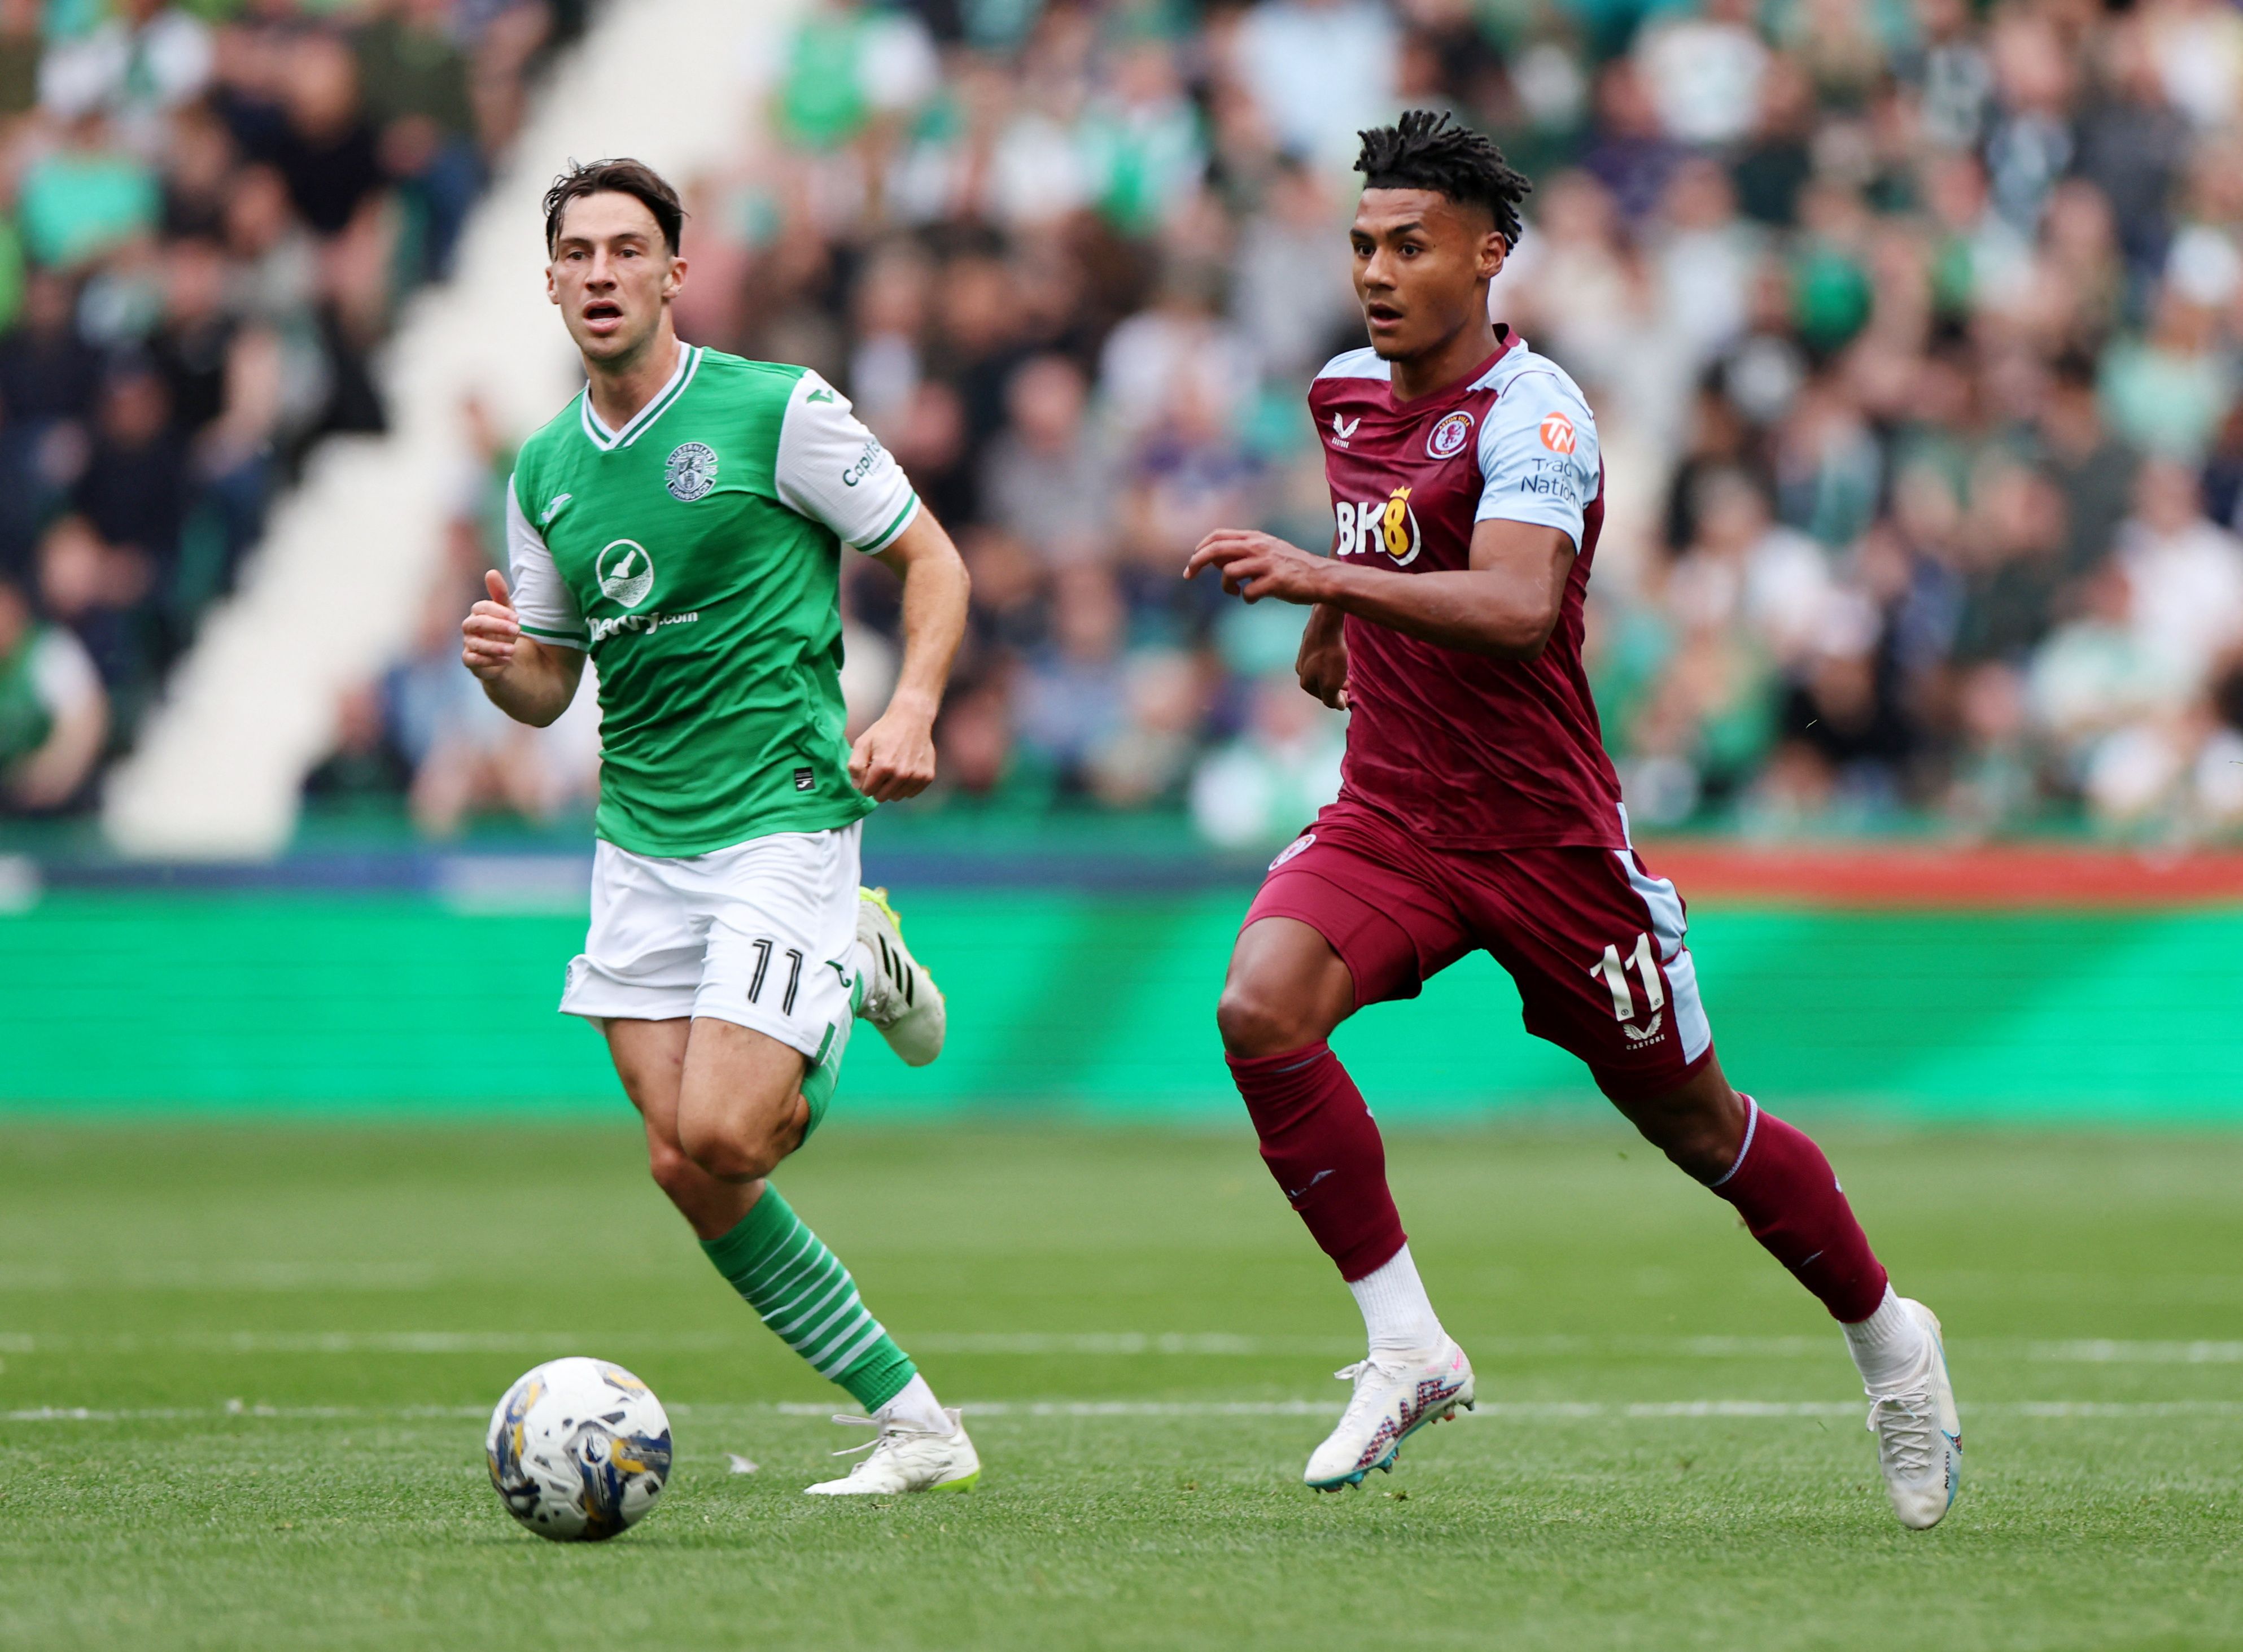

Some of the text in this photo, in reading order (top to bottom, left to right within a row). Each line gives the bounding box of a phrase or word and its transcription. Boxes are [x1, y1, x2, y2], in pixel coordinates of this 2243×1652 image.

[1521, 474, 1576, 508] Nation
[1336, 498, 1409, 556] BK8
[747, 938, 803, 1016] 11
[1589, 932, 1665, 1022] 11
[1626, 1033, 1665, 1050] CASTORE
